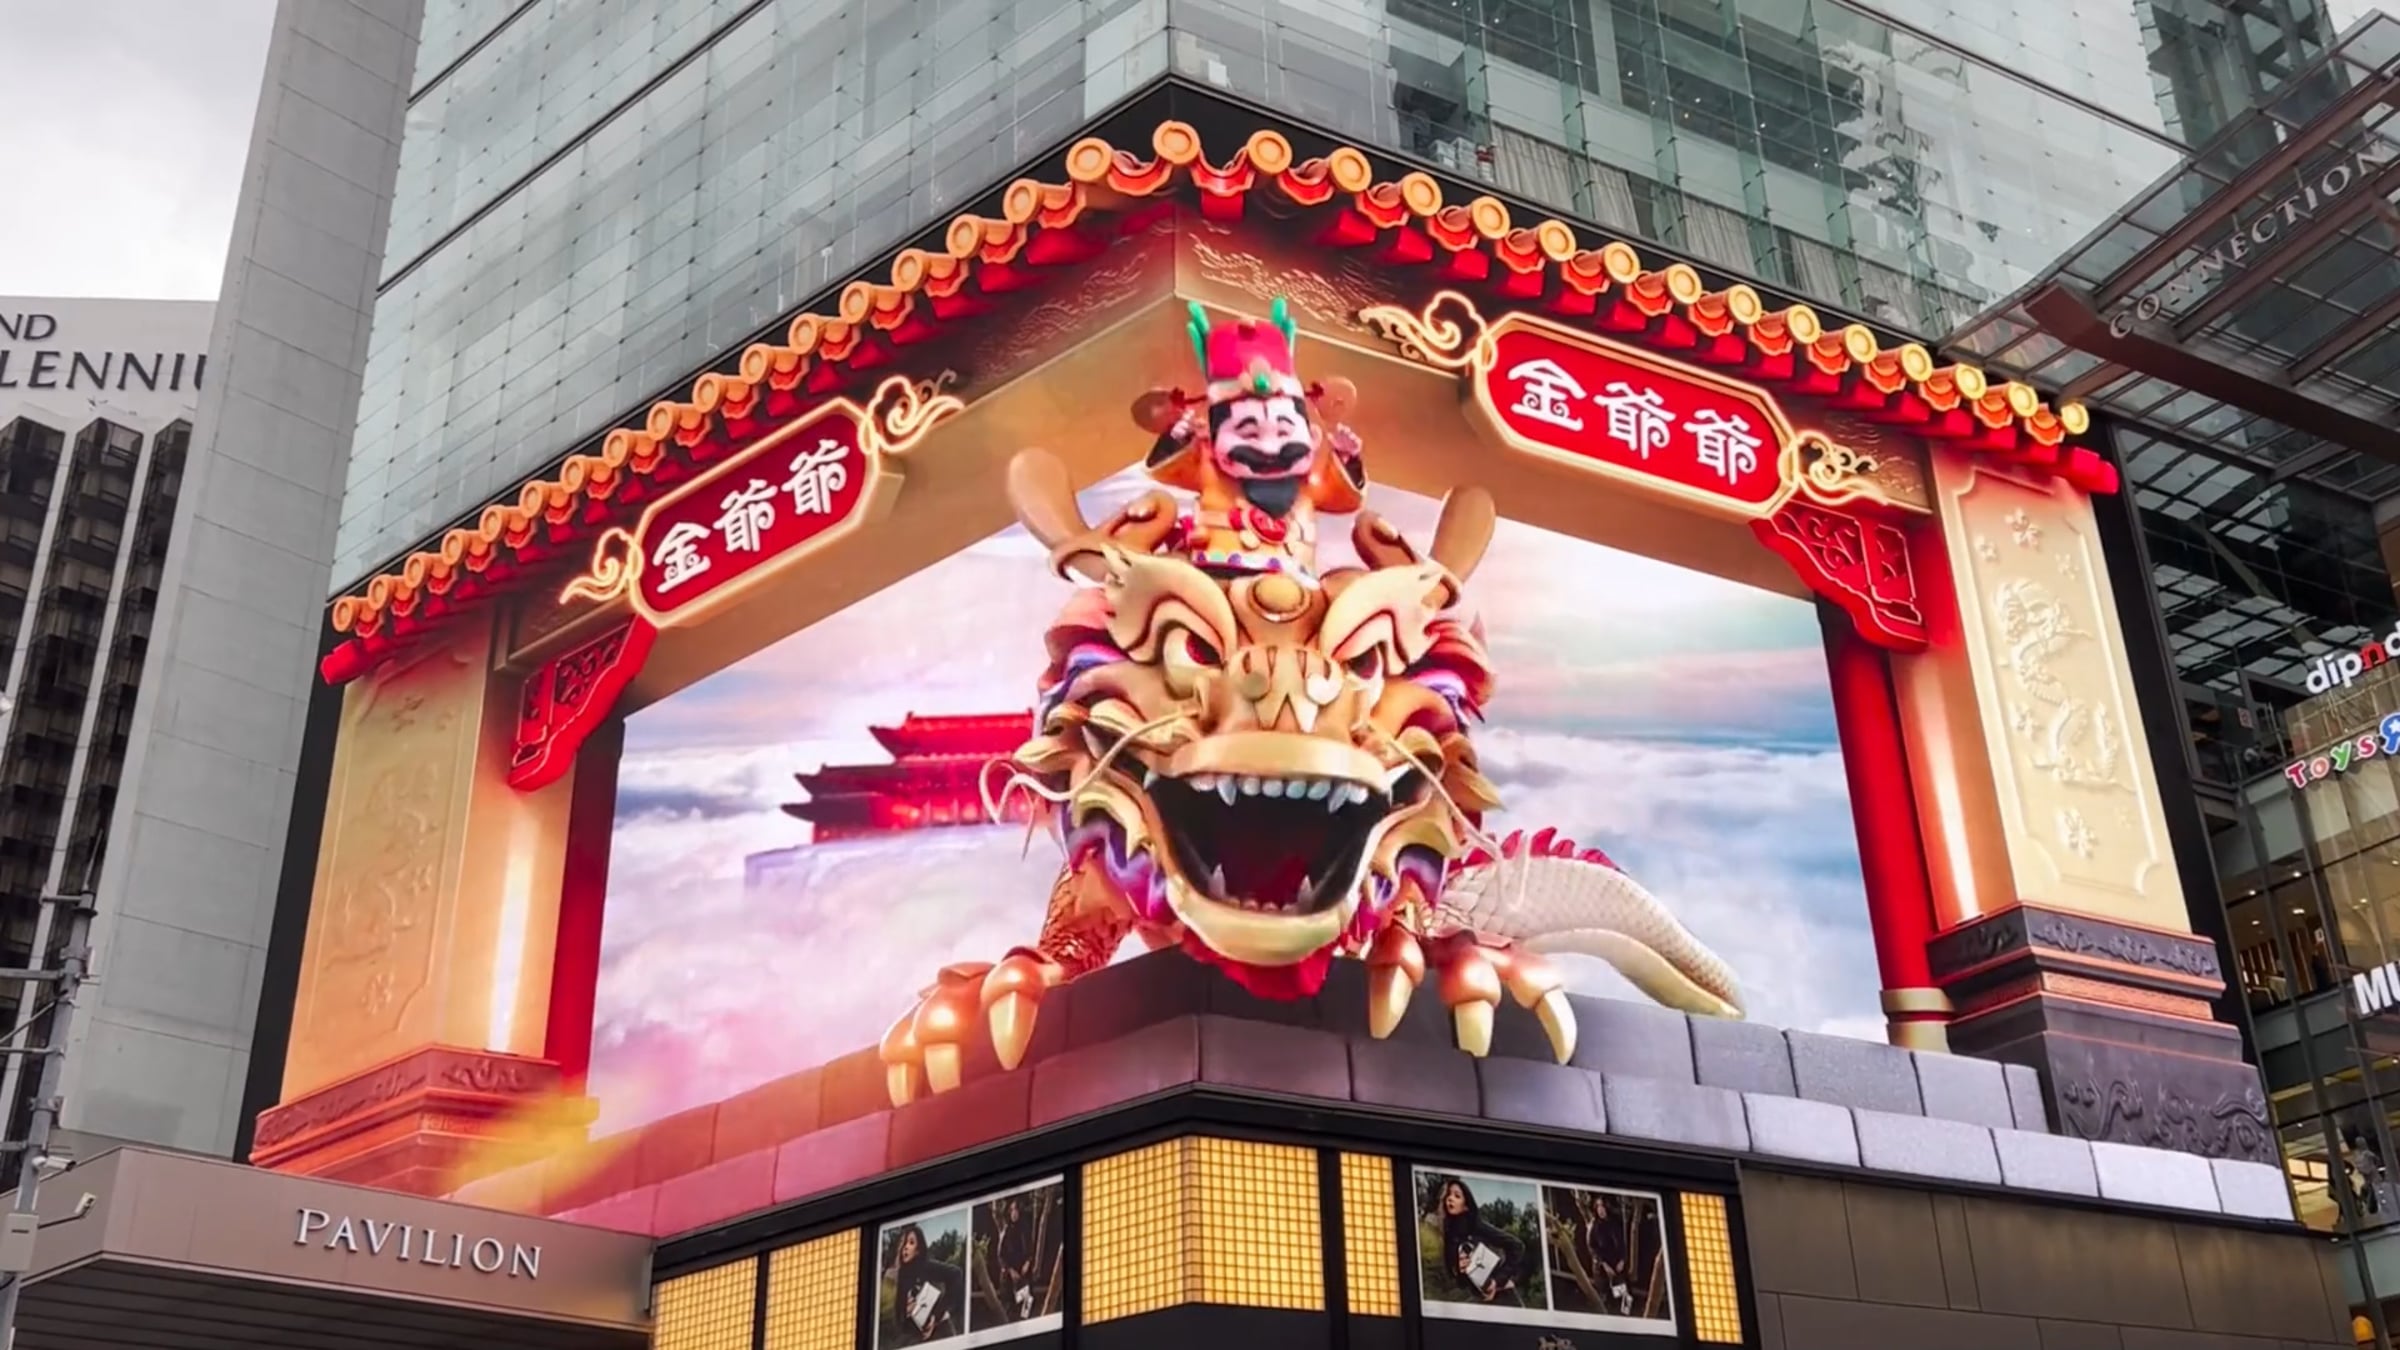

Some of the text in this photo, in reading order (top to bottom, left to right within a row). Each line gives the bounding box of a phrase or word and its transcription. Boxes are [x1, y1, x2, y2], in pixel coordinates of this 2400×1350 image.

[2109, 138, 2388, 339] CONNECTION
[0, 313, 57, 341] ND
[1507, 358, 1763, 487] 金爺爺
[652, 439, 849, 594] 金爺爺
[294, 1207, 542, 1279] PAVILION
